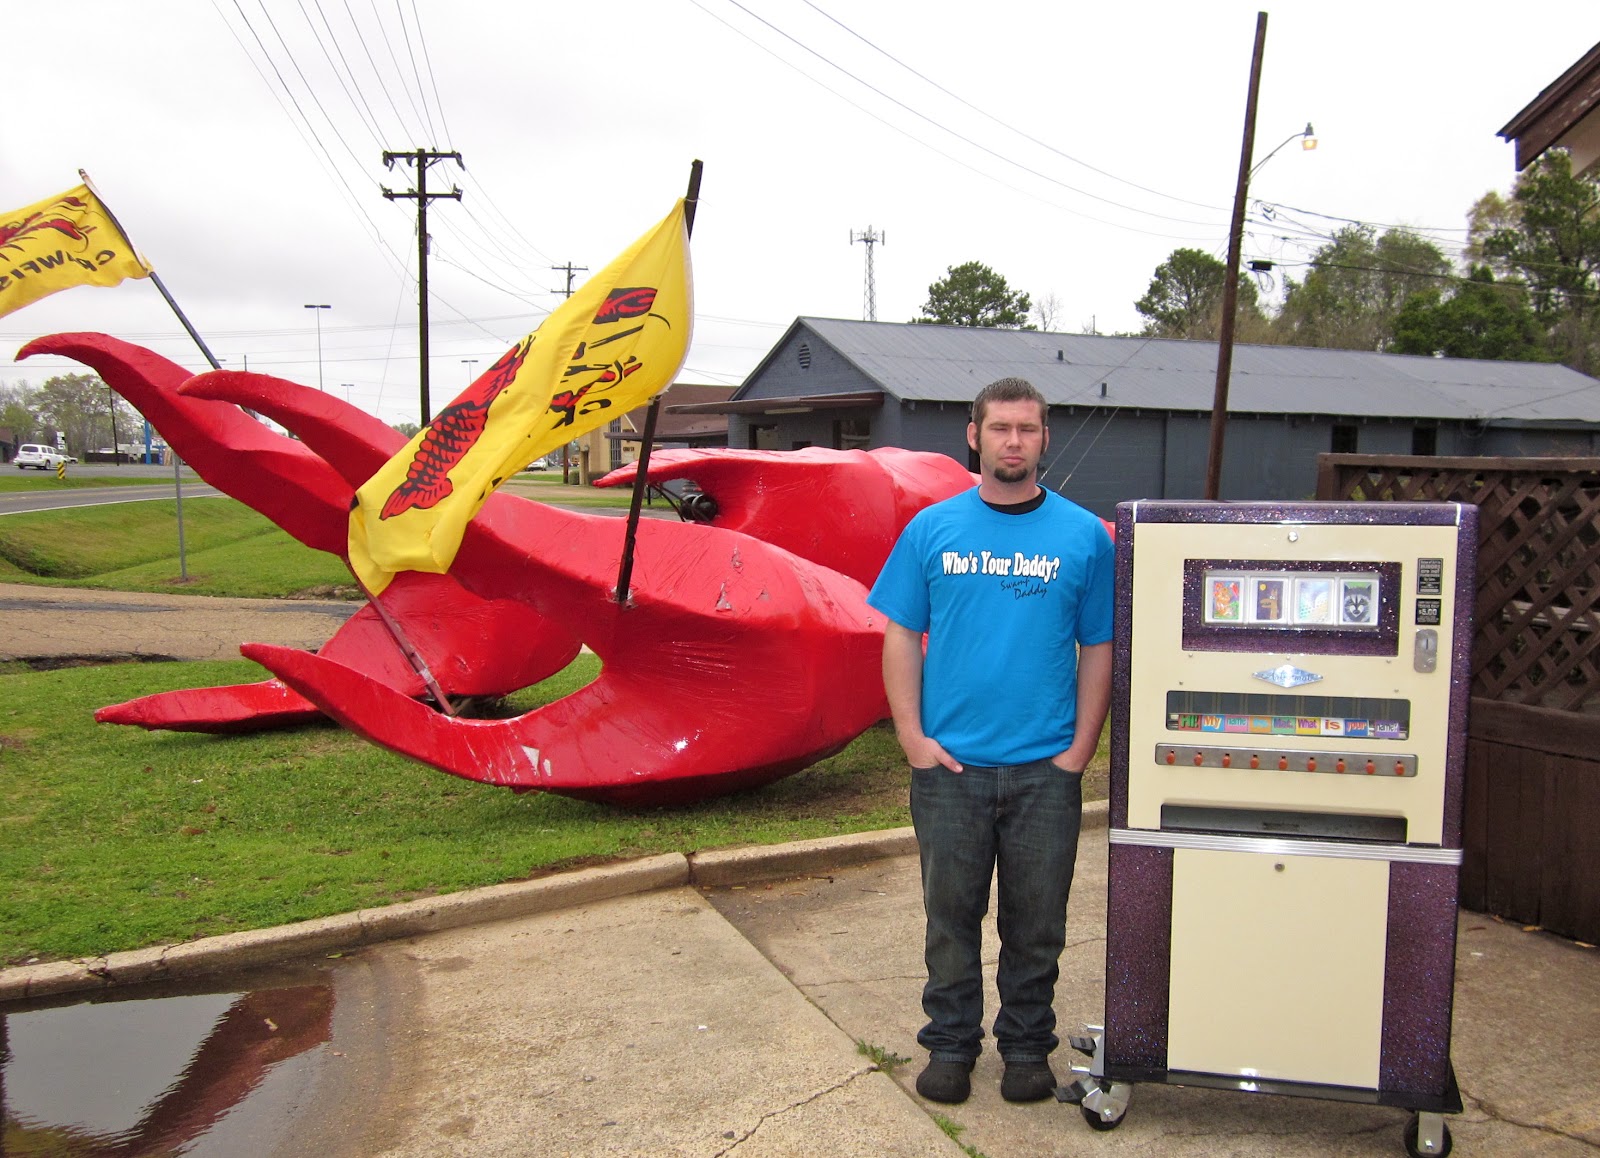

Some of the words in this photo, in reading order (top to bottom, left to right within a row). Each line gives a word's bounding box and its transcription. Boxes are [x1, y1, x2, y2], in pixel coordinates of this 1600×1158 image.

[942, 551, 978, 575] Who's
[980, 550, 1012, 576] Your
[1012, 551, 1061, 584] Daddy?
[1000, 577, 1030, 591] Swamp
[1014, 583, 1047, 600] Daddy
[1418, 608, 1437, 616] $5.00
[1204, 715, 1222, 729] My
[1297, 718, 1317, 729] What
[1325, 720, 1340, 730] is
[1347, 721, 1367, 732] your
